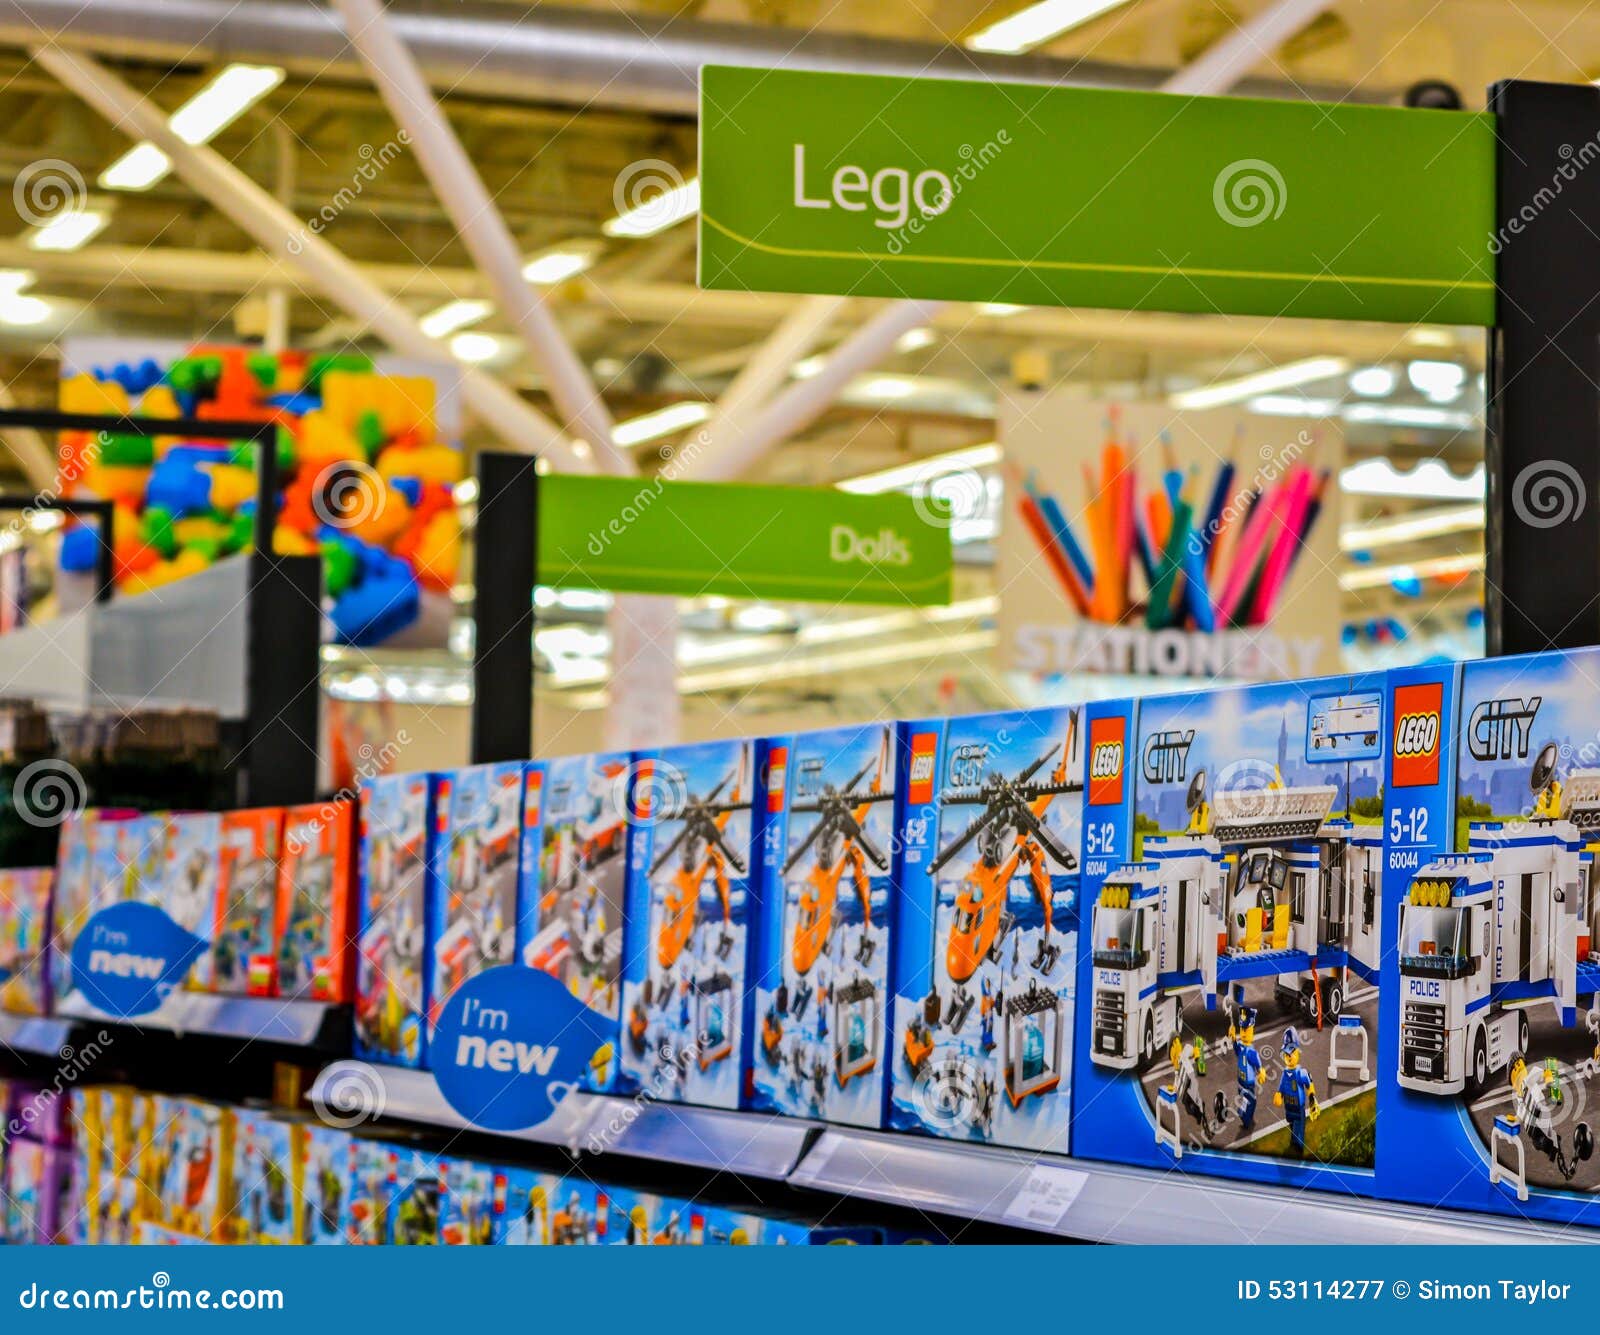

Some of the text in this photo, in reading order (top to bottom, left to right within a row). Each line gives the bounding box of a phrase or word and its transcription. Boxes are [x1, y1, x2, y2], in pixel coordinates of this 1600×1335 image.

[794, 143, 953, 229] Lego
[830, 524, 911, 566] Dolls
[1011, 620, 1324, 680] STATIONERY
[1395, 714, 1439, 756] LEGO
[1468, 696, 1542, 761] CITY
[1091, 743, 1122, 779] LEGO
[1143, 729, 1195, 784] CITY
[1086, 823, 1115, 853] 5-12
[1390, 807, 1428, 843] 5-12
[1389, 851, 1418, 869] 60044
[92, 925, 129, 946] I'm
[1495, 879, 1505, 979] POLICE
[89, 949, 167, 980] new
[1100, 970, 1121, 986] POLICE
[1410, 980, 1440, 998] POLICE
[461, 997, 509, 1031] I'm
[455, 1034, 560, 1076] new
